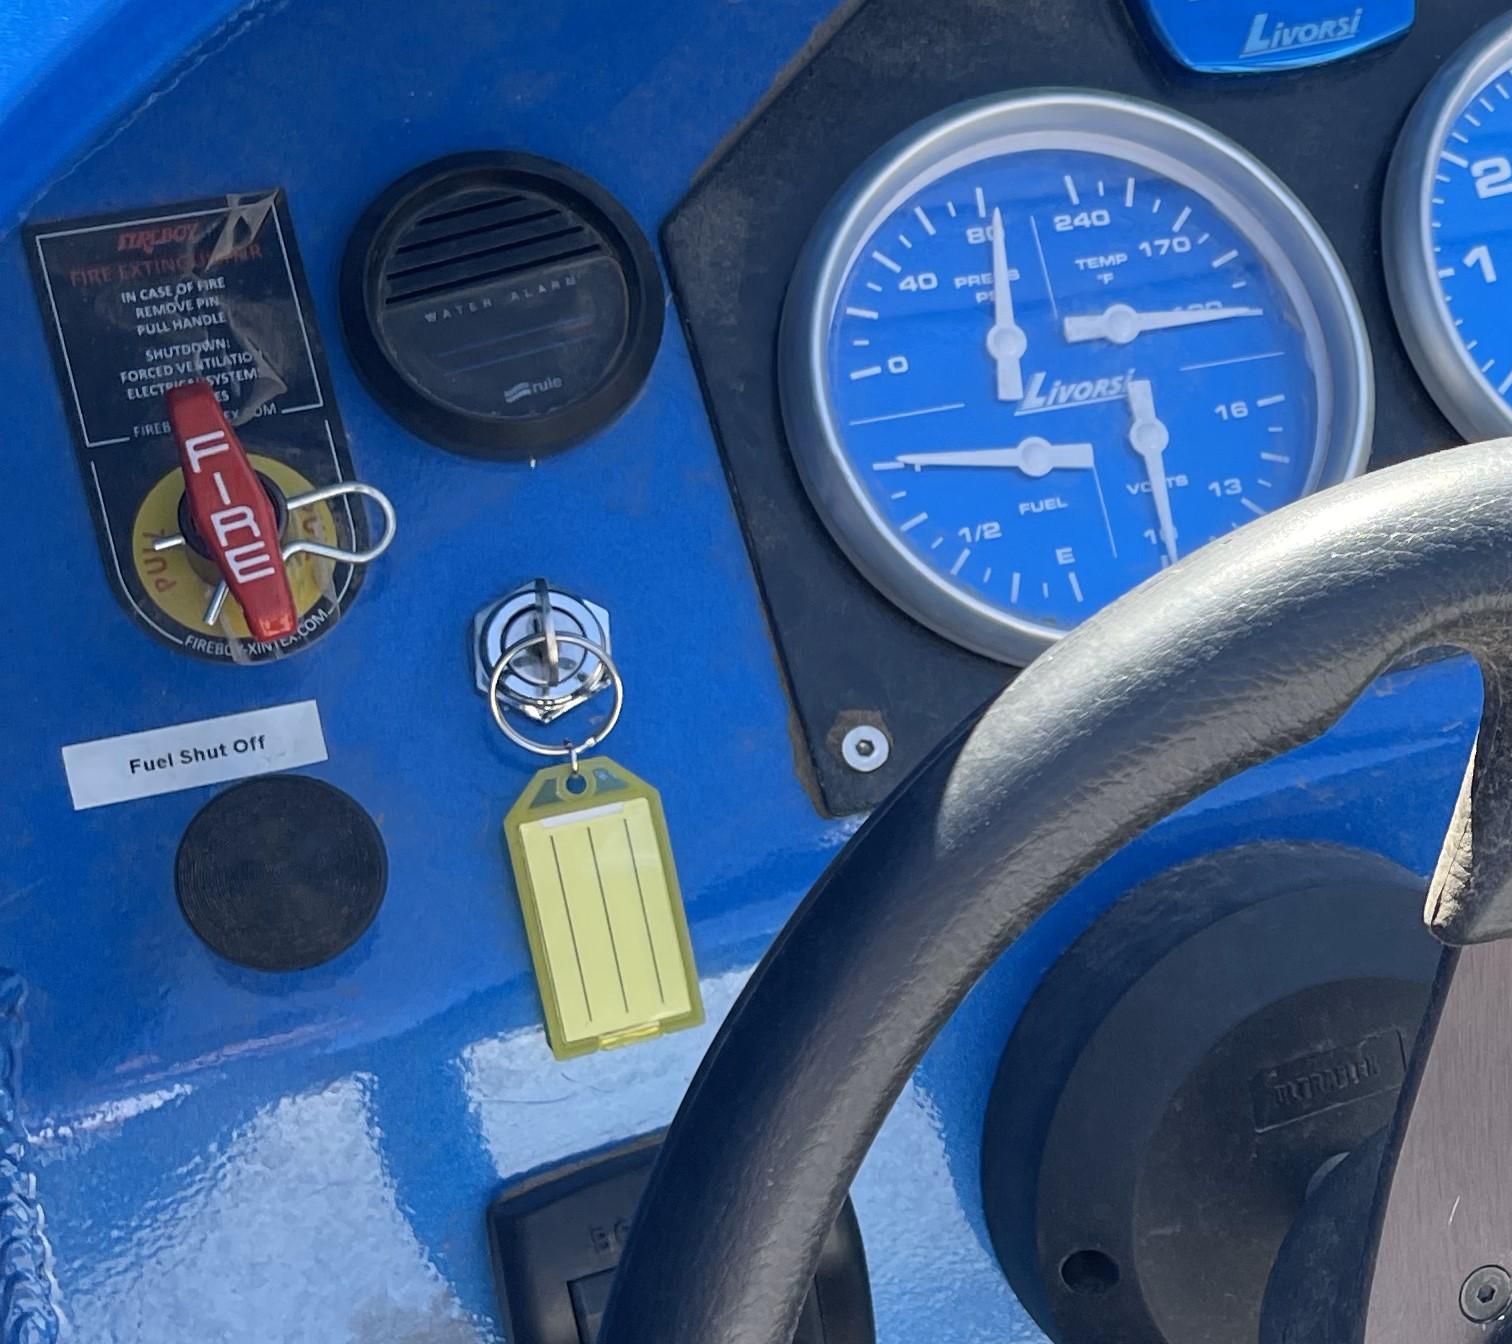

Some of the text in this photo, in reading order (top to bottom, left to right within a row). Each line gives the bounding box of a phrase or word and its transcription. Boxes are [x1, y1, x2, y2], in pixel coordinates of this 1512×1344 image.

[1054, 209, 1111, 232] 240
[1139, 236, 1192, 257] 170
[1075, 253, 1128, 270] TEMP
[1462, 245, 1498, 283] 1
[69, 267, 113, 288] FIRE
[898, 272, 939, 292] 40
[954, 268, 1020, 289] PRES
[121, 276, 225, 304] IN CASE OF FIRE
[425, 275, 577, 324] WATER ALARM
[135, 296, 219, 319] REMOVE PIN
[137, 312, 226, 336] PULL HANDLE
[120, 364, 174, 384] FORCED
[886, 356, 909, 374] 0
[1213, 401, 1249, 421] 16
[1126, 474, 1189, 495] VOTS
[1208, 478, 1242, 497] 13
[185, 430, 275, 584] FIRE
[1018, 497, 1068, 516] FUEL
[957, 521, 1002, 545] 1/2
[1056, 547, 1076, 564] E
[129, 733, 267, 775] Fuel Shut Off
